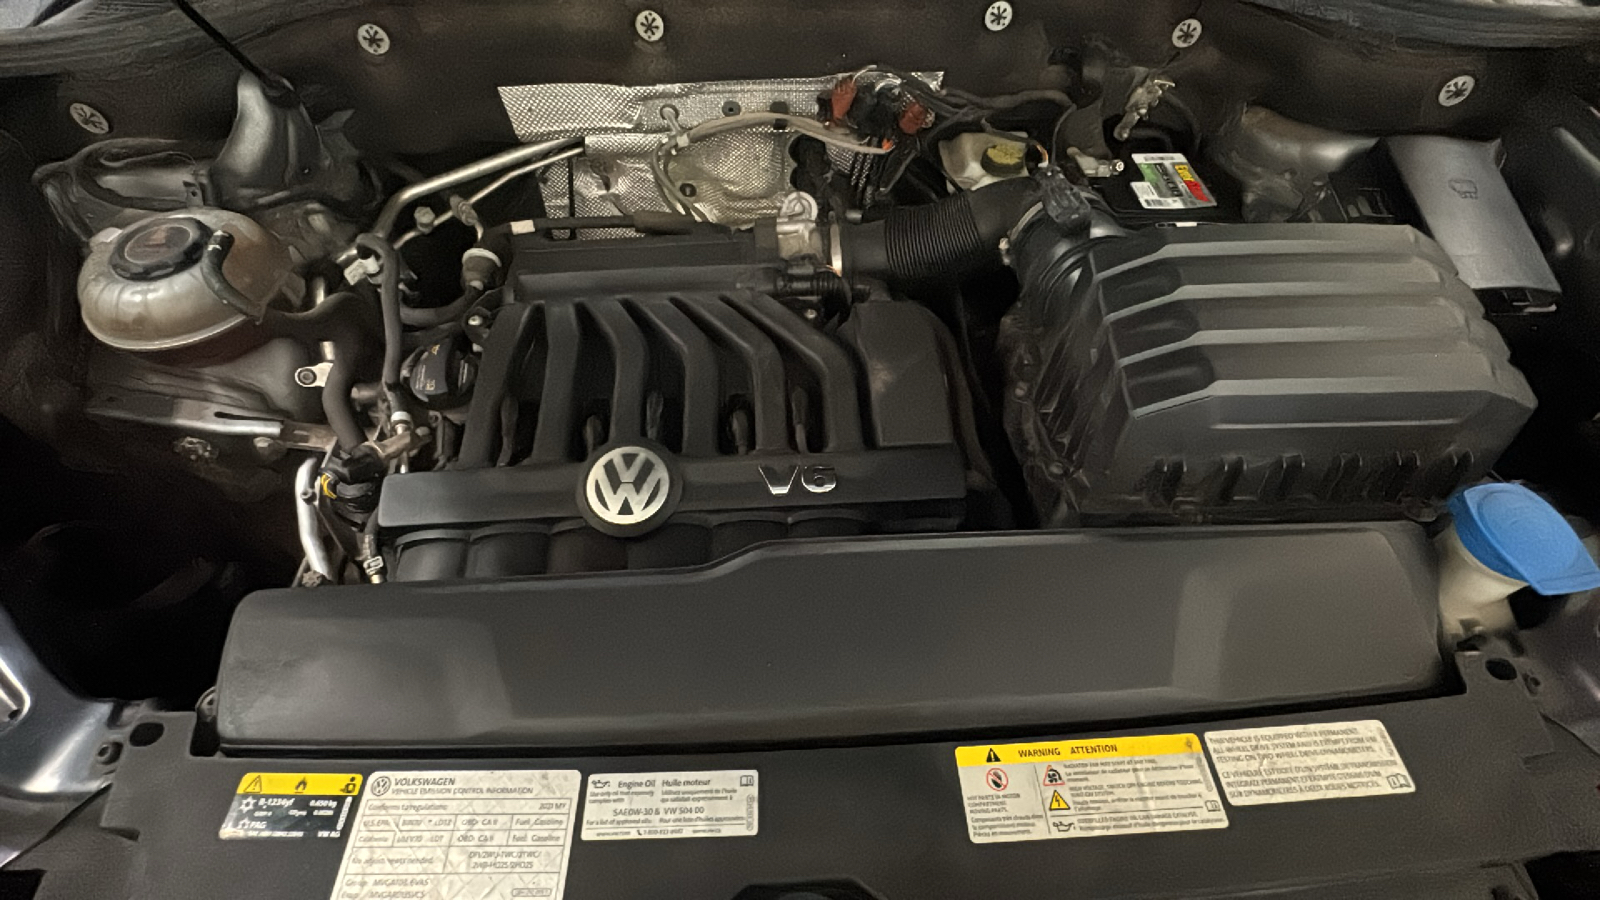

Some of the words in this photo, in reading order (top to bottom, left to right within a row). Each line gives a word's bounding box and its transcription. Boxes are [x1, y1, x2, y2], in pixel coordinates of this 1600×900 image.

[758, 464, 837, 496] V6
[1018, 748, 1061, 758] WARNING
[1070, 744, 1118, 754] ATTENTION
[394, 778, 455, 786] VOLKSWAGEN
[618, 780, 643, 790] Engine
[645, 779, 655, 787] Oil
[662, 778, 682, 787] Huile
[683, 778, 711, 786] moteur
[453, 787, 484, 795] CONTROL
[664, 807, 677, 815] VW
[532, 834, 561, 842] Gasoline
